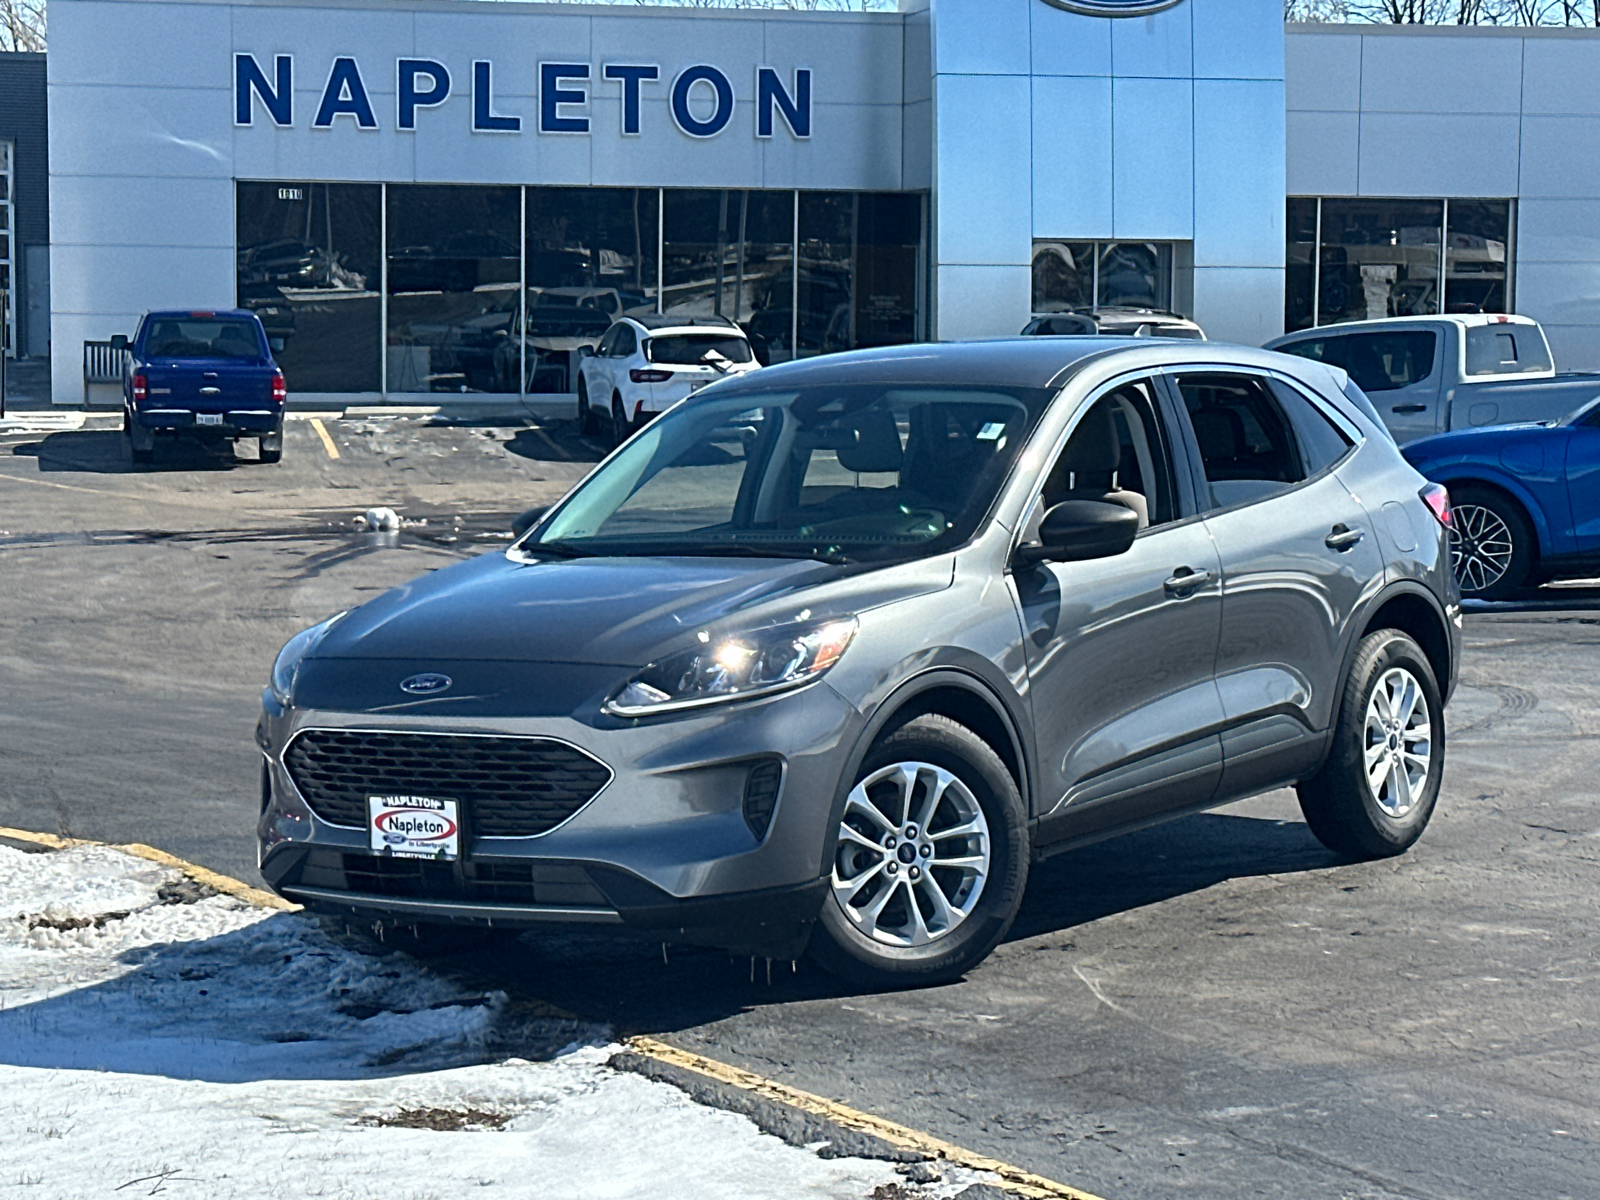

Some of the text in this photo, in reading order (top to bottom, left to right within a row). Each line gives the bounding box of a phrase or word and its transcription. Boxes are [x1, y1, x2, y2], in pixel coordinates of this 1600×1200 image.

[233, 52, 812, 140] NAPLETON
[386, 796, 438, 809] NAPLETON
[388, 816, 443, 835] Napleton
[392, 851, 436, 860] LIBERTYVILLE
